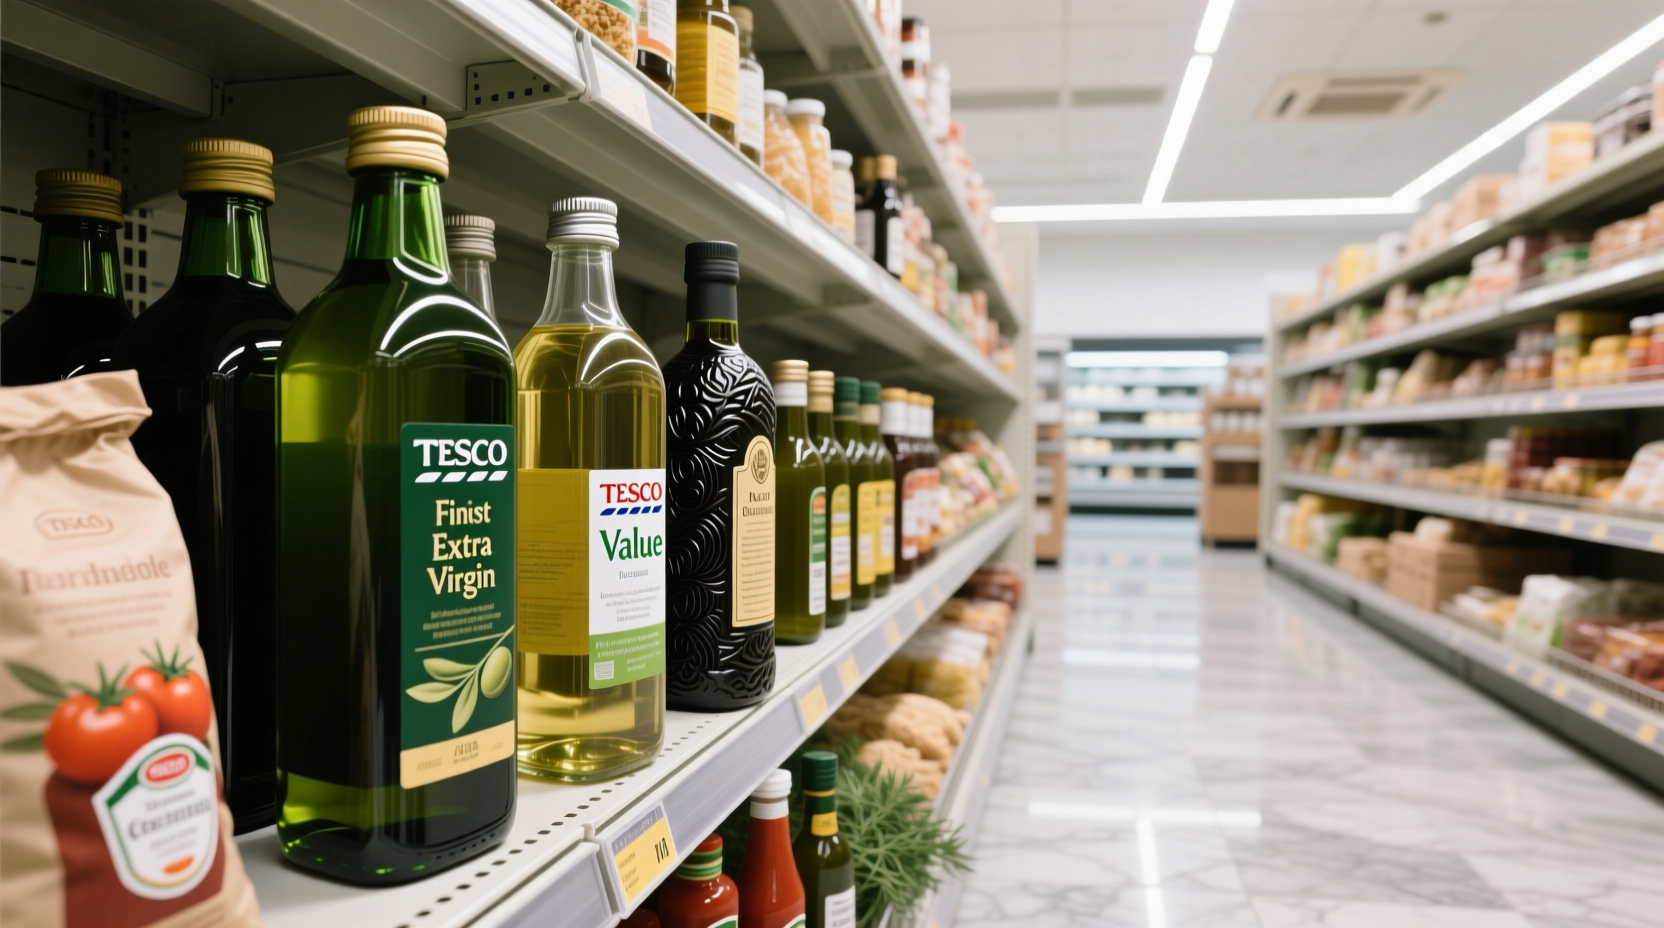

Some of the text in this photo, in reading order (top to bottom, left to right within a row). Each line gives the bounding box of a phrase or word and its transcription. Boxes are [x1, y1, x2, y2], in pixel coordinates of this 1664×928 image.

[413, 439, 508, 467] TESCO
[599, 482, 662, 504] TESCO
[435, 499, 491, 526] Finist
[432, 532, 493, 561] Extra
[599, 526, 663, 562] Value
[426, 562, 496, 600] Virgin
